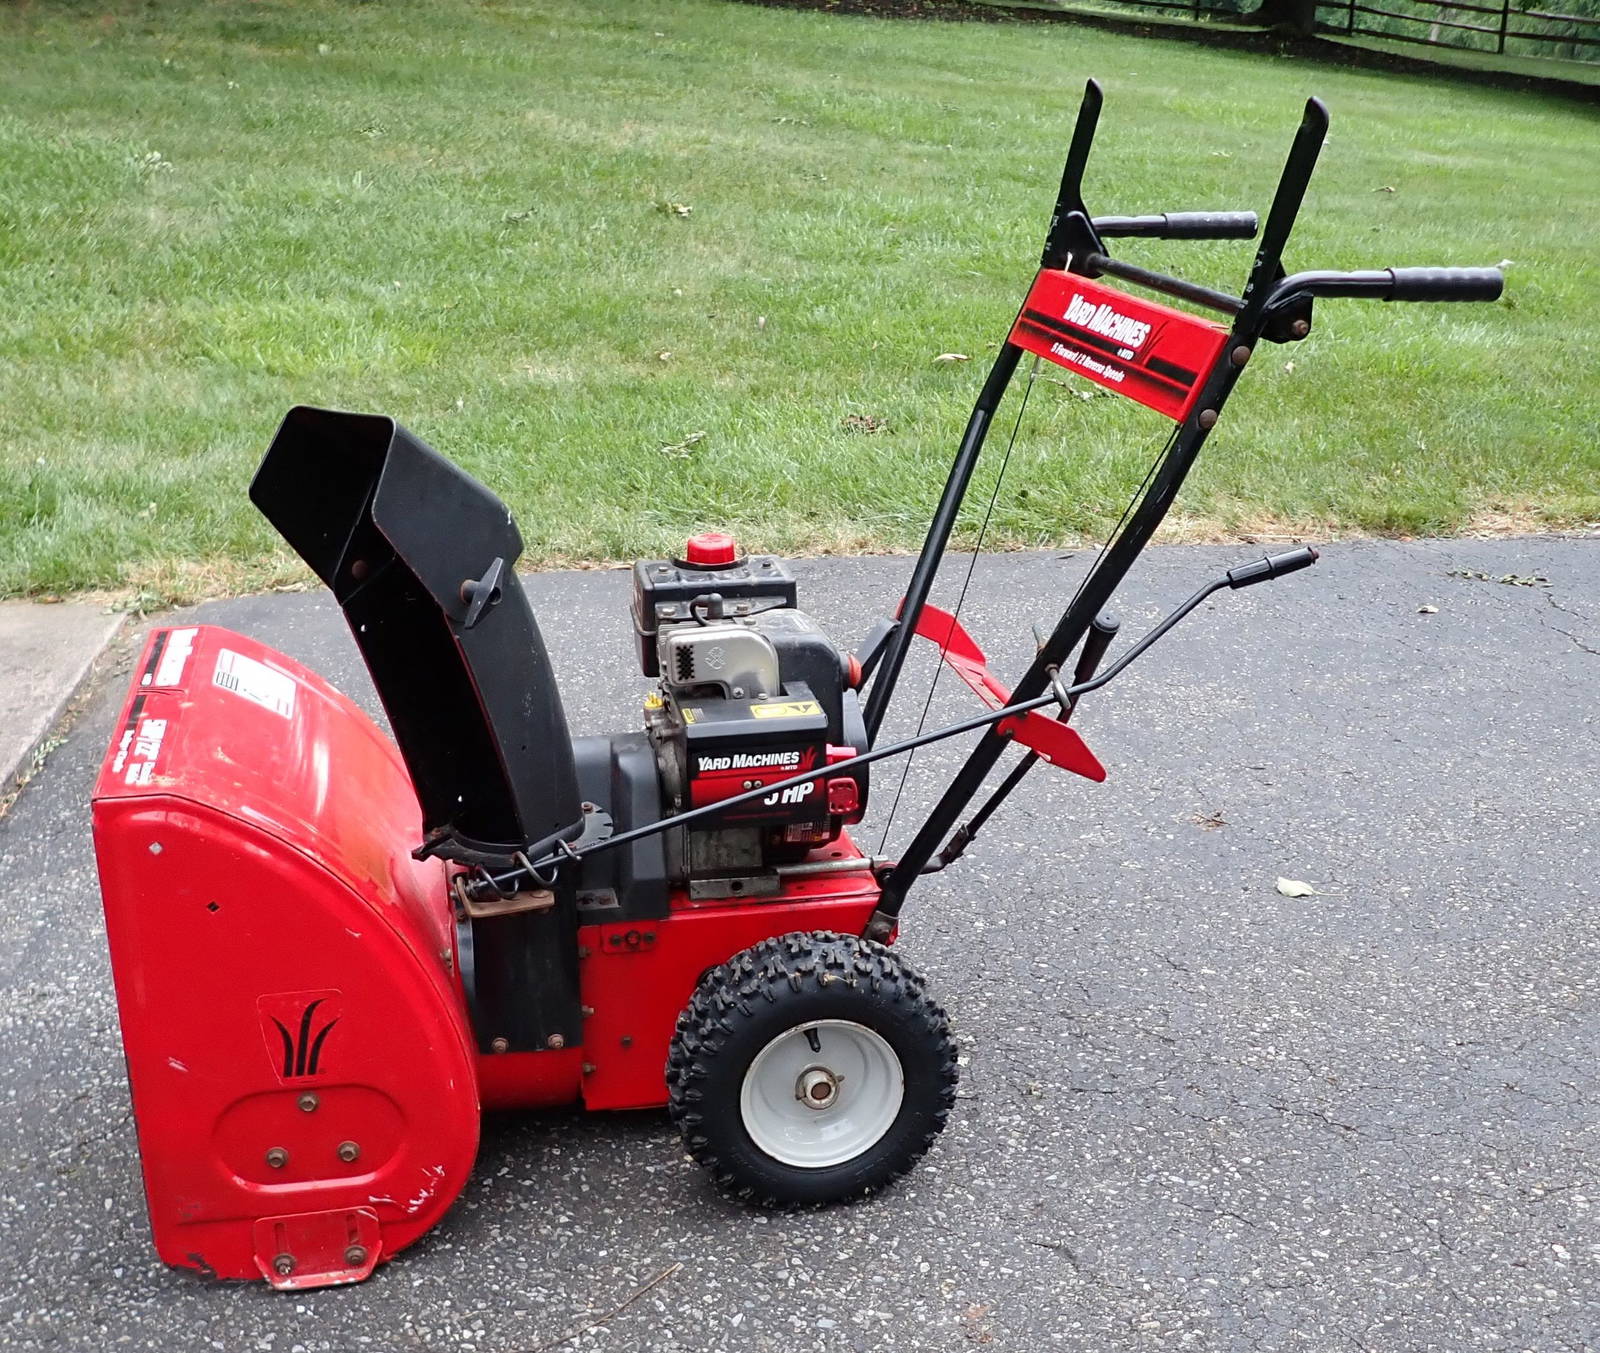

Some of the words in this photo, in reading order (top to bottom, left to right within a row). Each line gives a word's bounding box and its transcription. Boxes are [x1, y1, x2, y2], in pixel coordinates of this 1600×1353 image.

[1063, 293, 1097, 326] YARD
[1087, 303, 1152, 348] MACHINES
[1102, 365, 1126, 383] Speeds
[698, 756, 731, 771] YARD
[732, 751, 800, 769] MACHINES
[781, 781, 815, 804] HP
